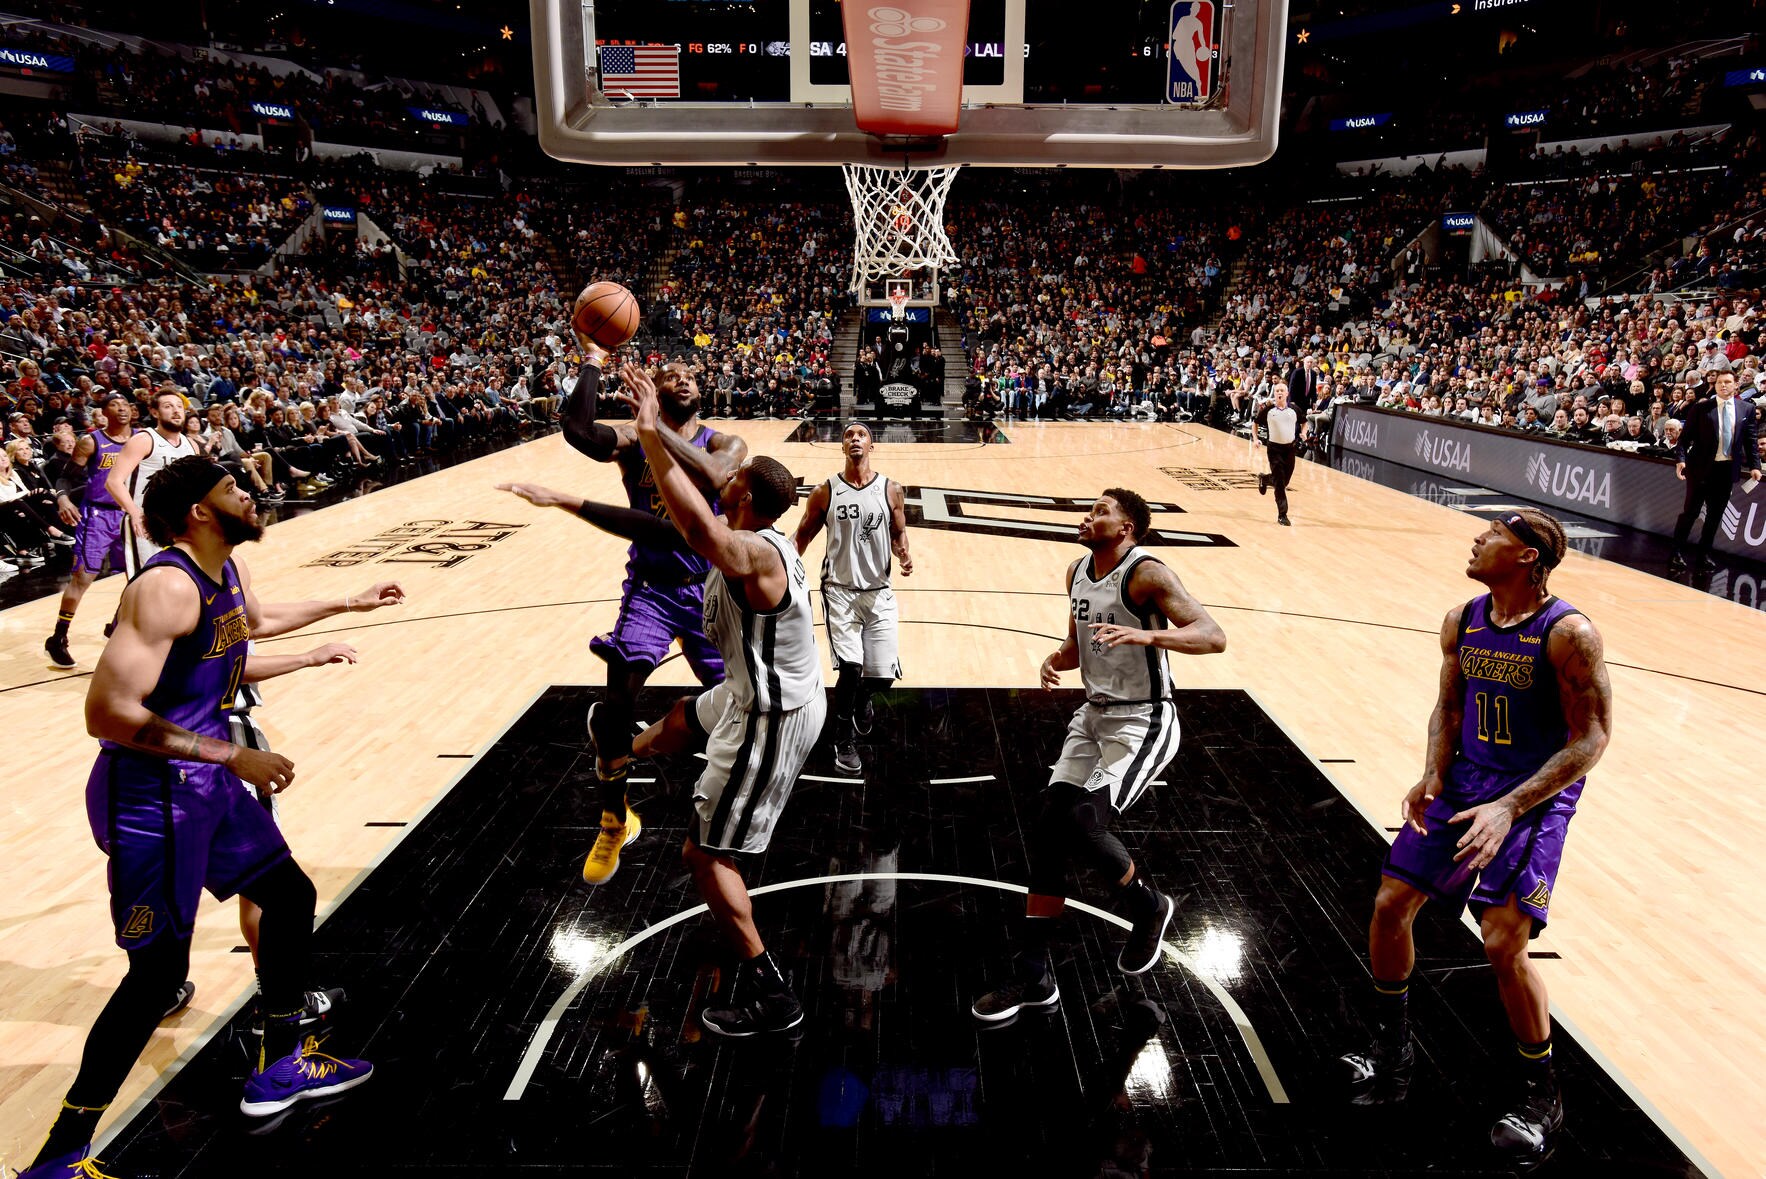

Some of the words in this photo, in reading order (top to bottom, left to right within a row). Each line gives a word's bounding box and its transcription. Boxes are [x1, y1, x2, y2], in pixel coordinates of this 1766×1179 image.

[689, 43, 703, 53] FG
[707, 43, 732, 54] 62%
[740, 43, 746, 53] F
[975, 43, 1003, 57] LAL
[15, 53, 48, 67] USAA
[1173, 82, 1193, 97] NBA
[265, 106, 291, 118] USAA
[431, 112, 453, 123] USAA
[1520, 113, 1545, 124] USAA
[1355, 117, 1376, 127] USAA
[332, 210, 351, 219] USAA
[1455, 218, 1474, 226] USAA
[1350, 419, 1379, 449] USAA
[1432, 437, 1471, 473] USAA
[1552, 462, 1612, 509] USAA
[836, 503, 860, 520] 33
[374, 519, 532, 569] AT&T
[1518, 633, 1541, 645] wish
[1473, 647, 1492, 657] LOS
[1492, 651, 1535, 664] ANGELES
[1459, 645, 1534, 690] LAKERS
[1475, 691, 1512, 745] 11
